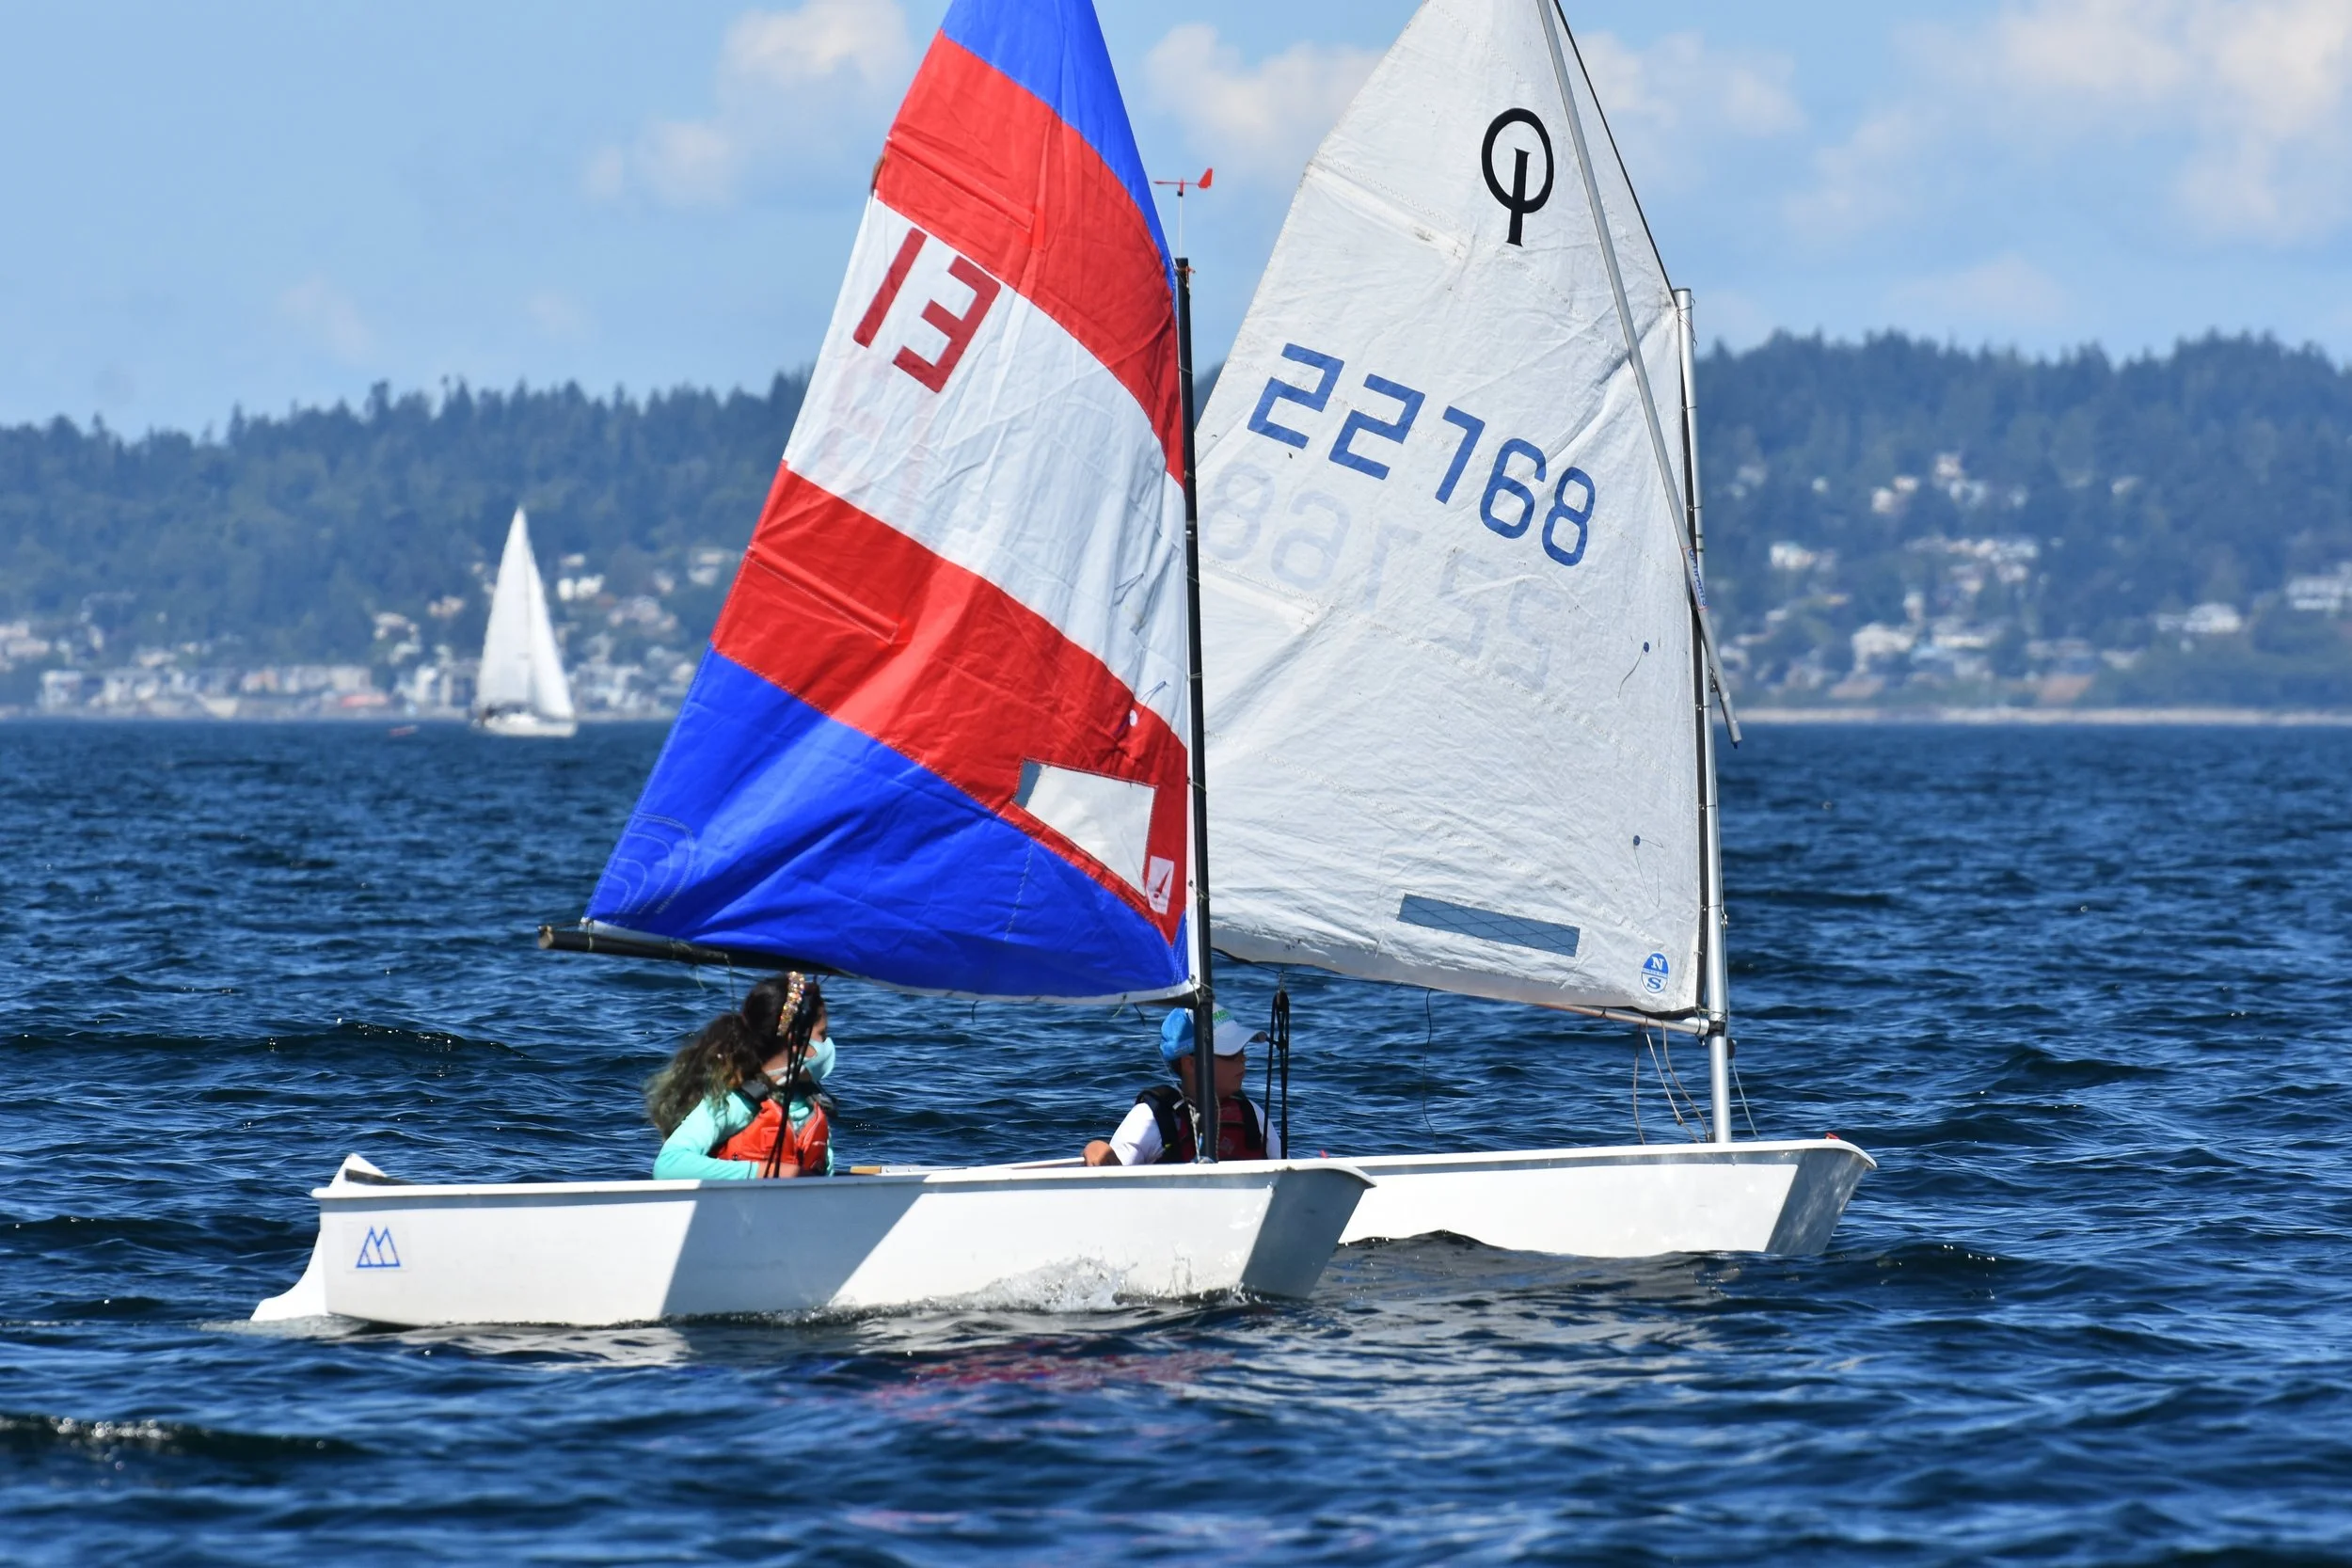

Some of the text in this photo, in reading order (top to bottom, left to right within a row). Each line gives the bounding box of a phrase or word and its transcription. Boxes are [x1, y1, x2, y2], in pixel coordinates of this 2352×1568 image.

[852, 226, 1001, 394] 13
[1247, 342, 1596, 566] 22768
[1646, 976, 1661, 990] S
[1650, 956, 1664, 971] N
